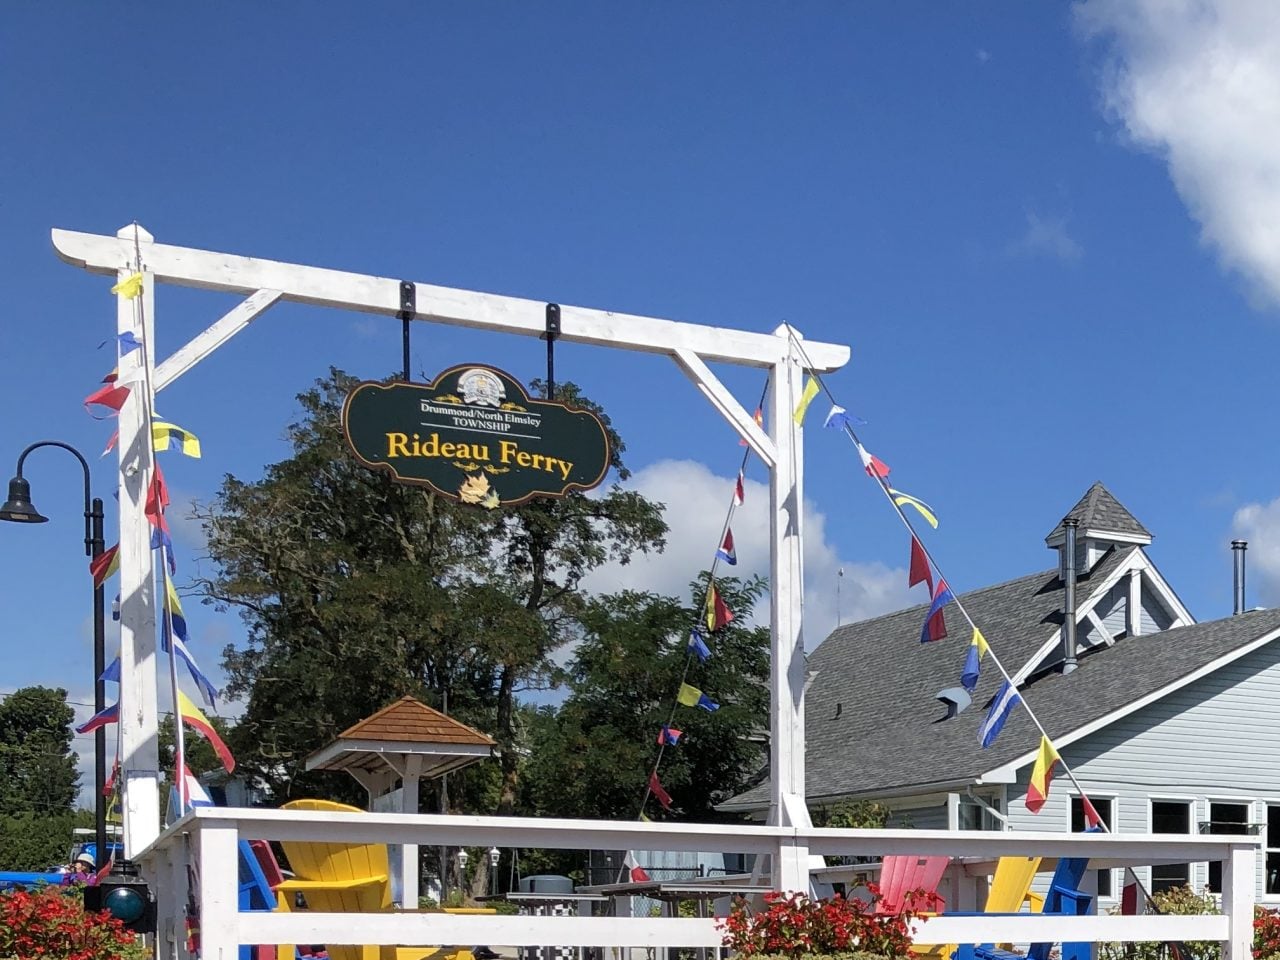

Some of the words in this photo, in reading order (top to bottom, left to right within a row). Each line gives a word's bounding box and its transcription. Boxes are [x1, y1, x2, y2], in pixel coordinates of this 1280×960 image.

[421, 403, 503, 421] Drummond/North
[504, 413, 541, 428] Elmsley
[452, 417, 511, 432] TOWNSHIP
[386, 432, 490, 461] Rideau
[499, 440, 574, 481] Ferry
